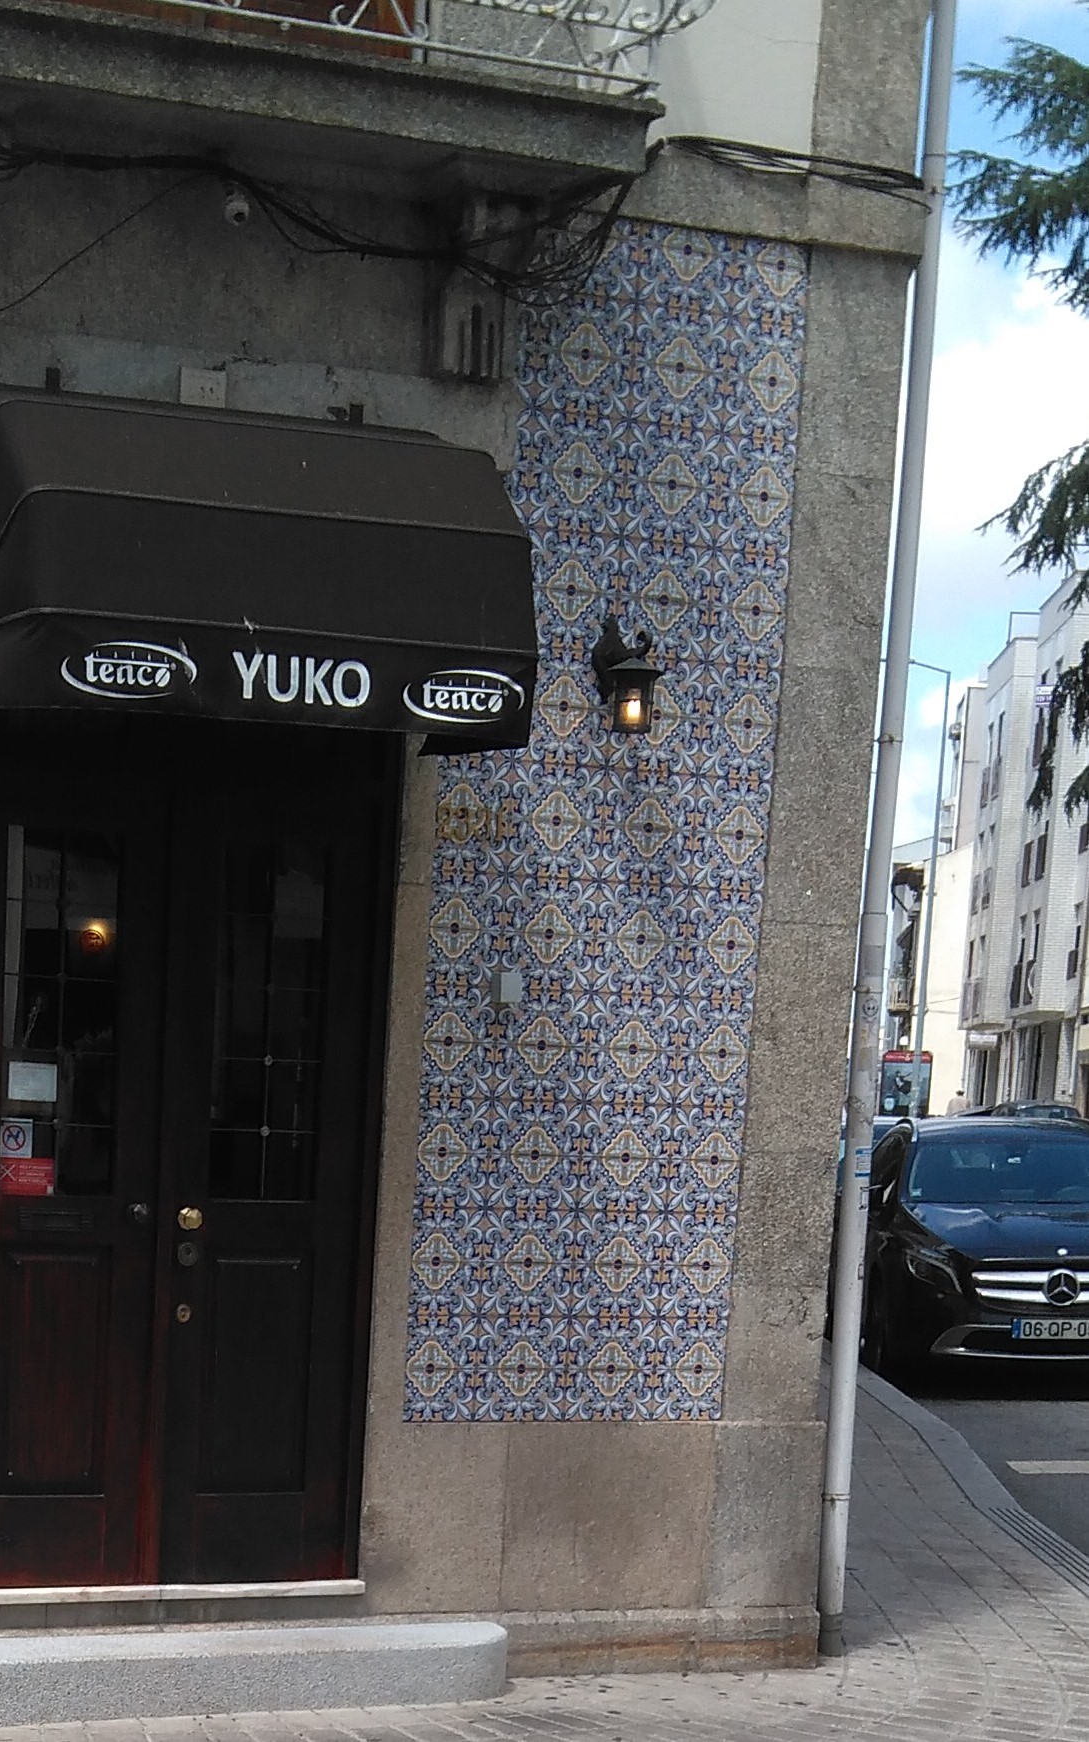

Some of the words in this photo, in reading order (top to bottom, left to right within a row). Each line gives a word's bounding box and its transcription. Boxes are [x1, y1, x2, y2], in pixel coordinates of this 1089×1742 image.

[84, 652, 171, 688] tenco
[232, 650, 371, 707] YUKO
[422, 680, 505, 713] tenco
